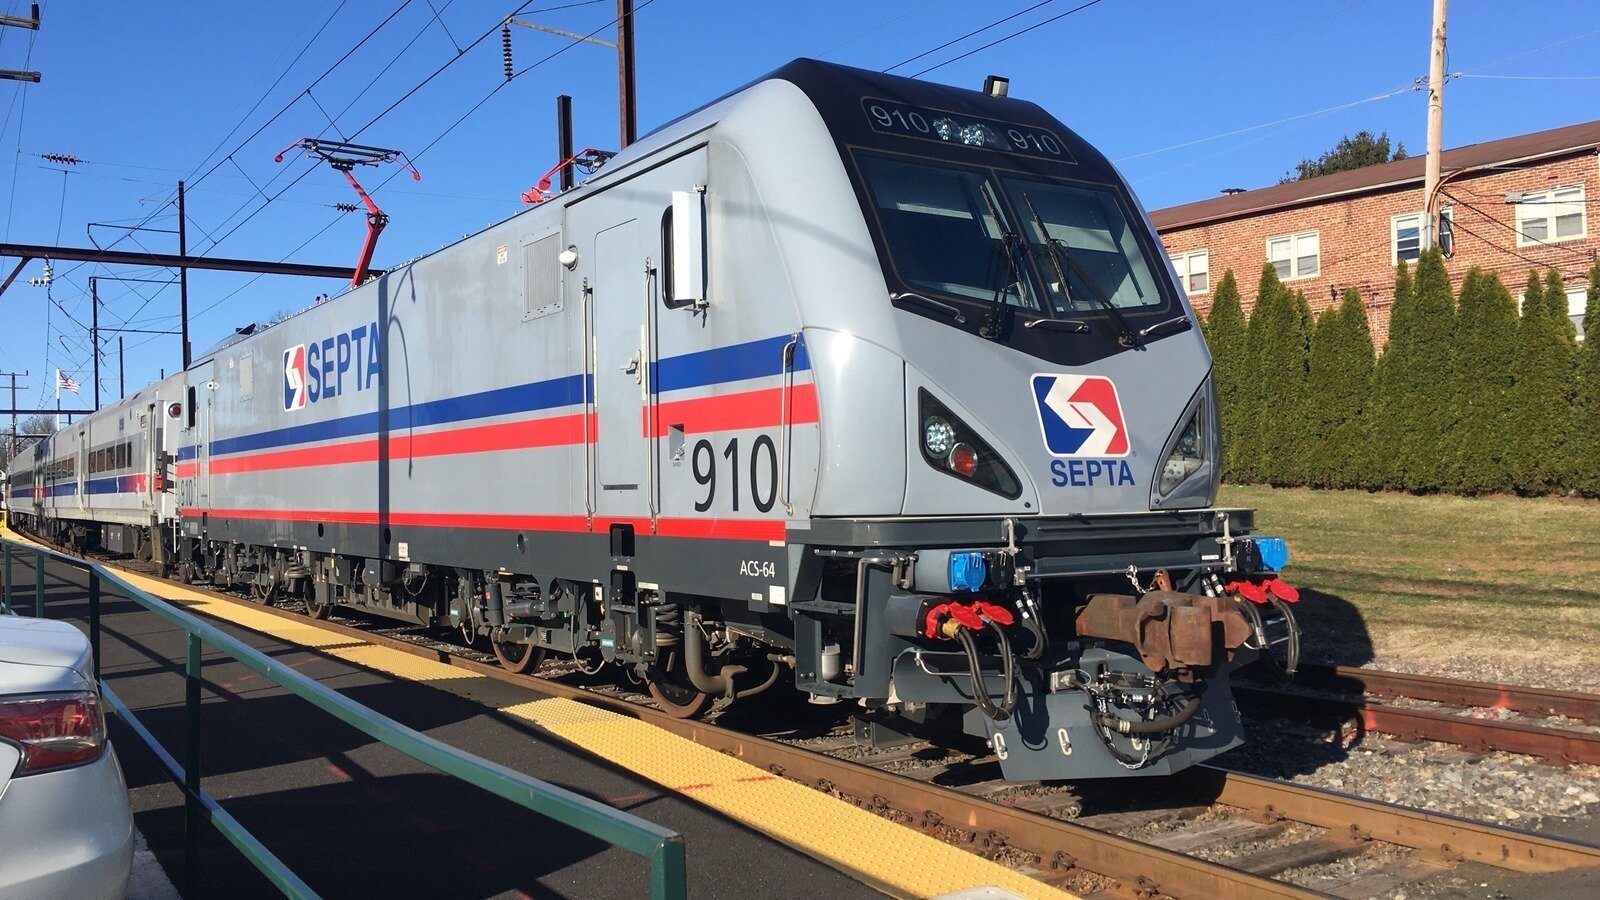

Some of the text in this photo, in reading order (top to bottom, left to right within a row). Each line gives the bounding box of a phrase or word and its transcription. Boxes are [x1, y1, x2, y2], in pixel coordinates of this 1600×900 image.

[870, 105, 930, 133] 910
[1007, 129, 1061, 155] 910
[307, 321, 384, 403] SEPTA
[692, 434, 778, 513] 910
[1050, 460, 1135, 487] SEPTA
[740, 560, 775, 578] ACS-64
